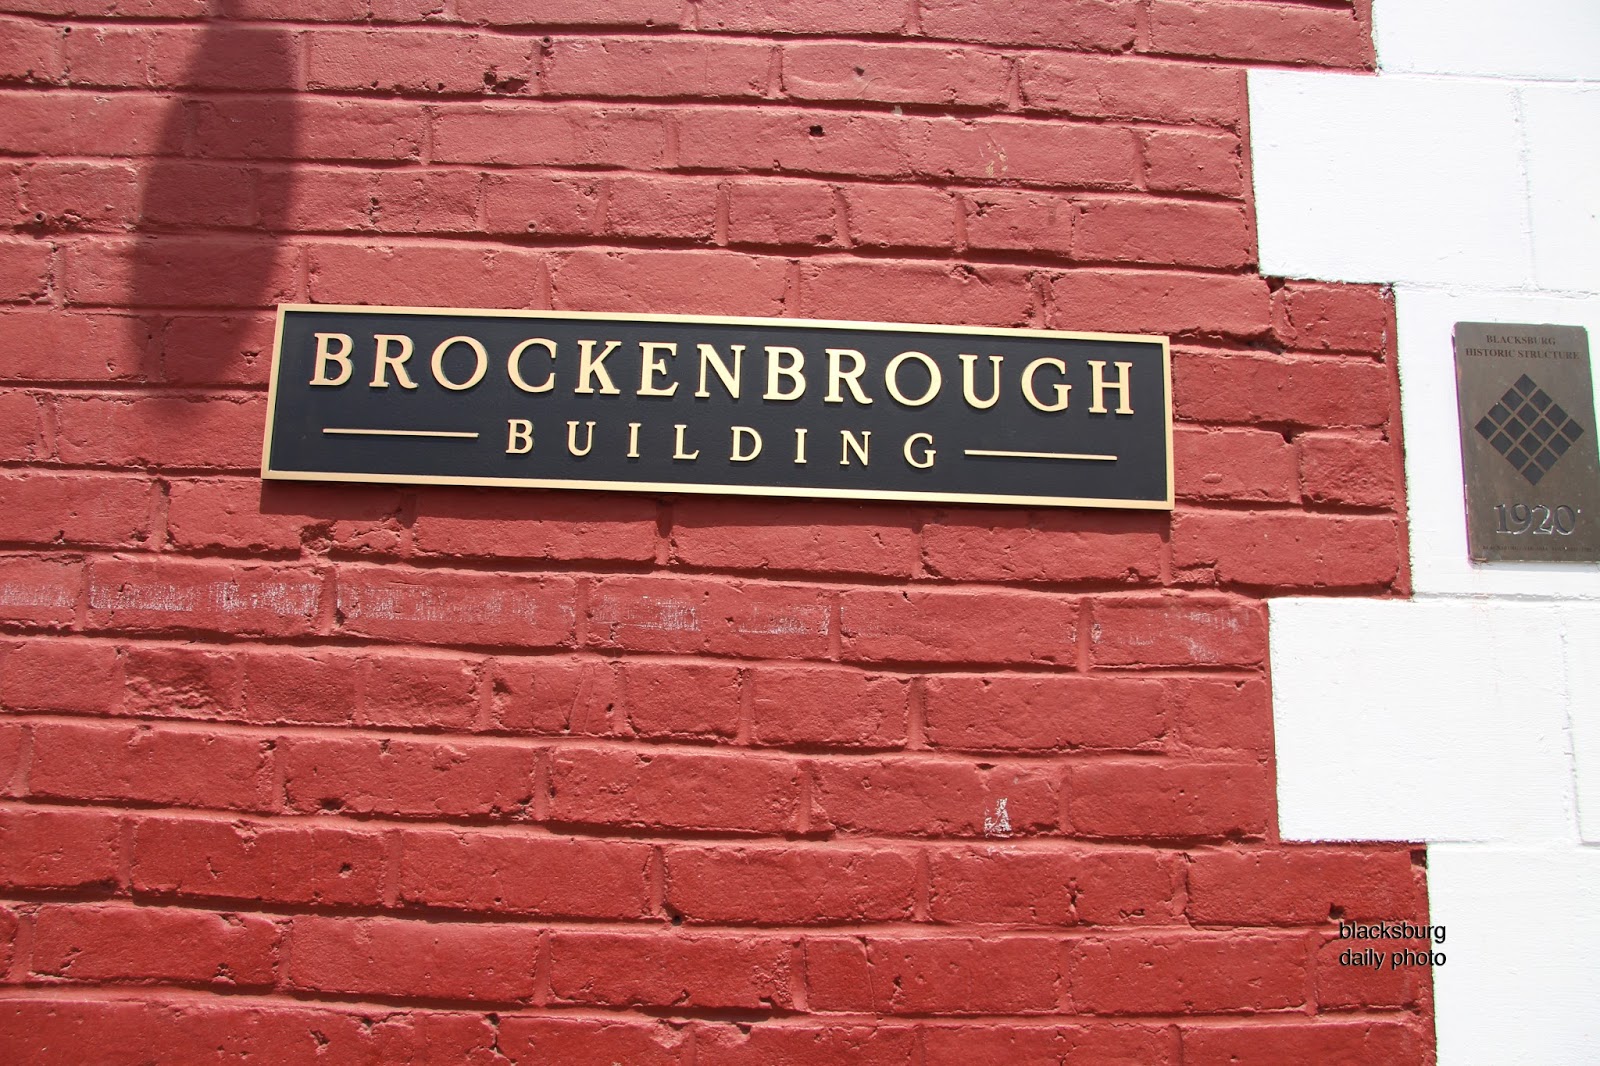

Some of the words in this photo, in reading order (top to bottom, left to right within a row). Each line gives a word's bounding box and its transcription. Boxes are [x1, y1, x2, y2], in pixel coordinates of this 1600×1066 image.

[1465, 348, 1514, 358] HISTORIC
[1518, 350, 1580, 360] STRUCTURE
[1486, 334, 1556, 345] BLACKSBURG
[309, 332, 1134, 415] BROCKENBROUGH
[505, 418, 936, 468] BUILDING
[1493, 503, 1576, 536] 1920
